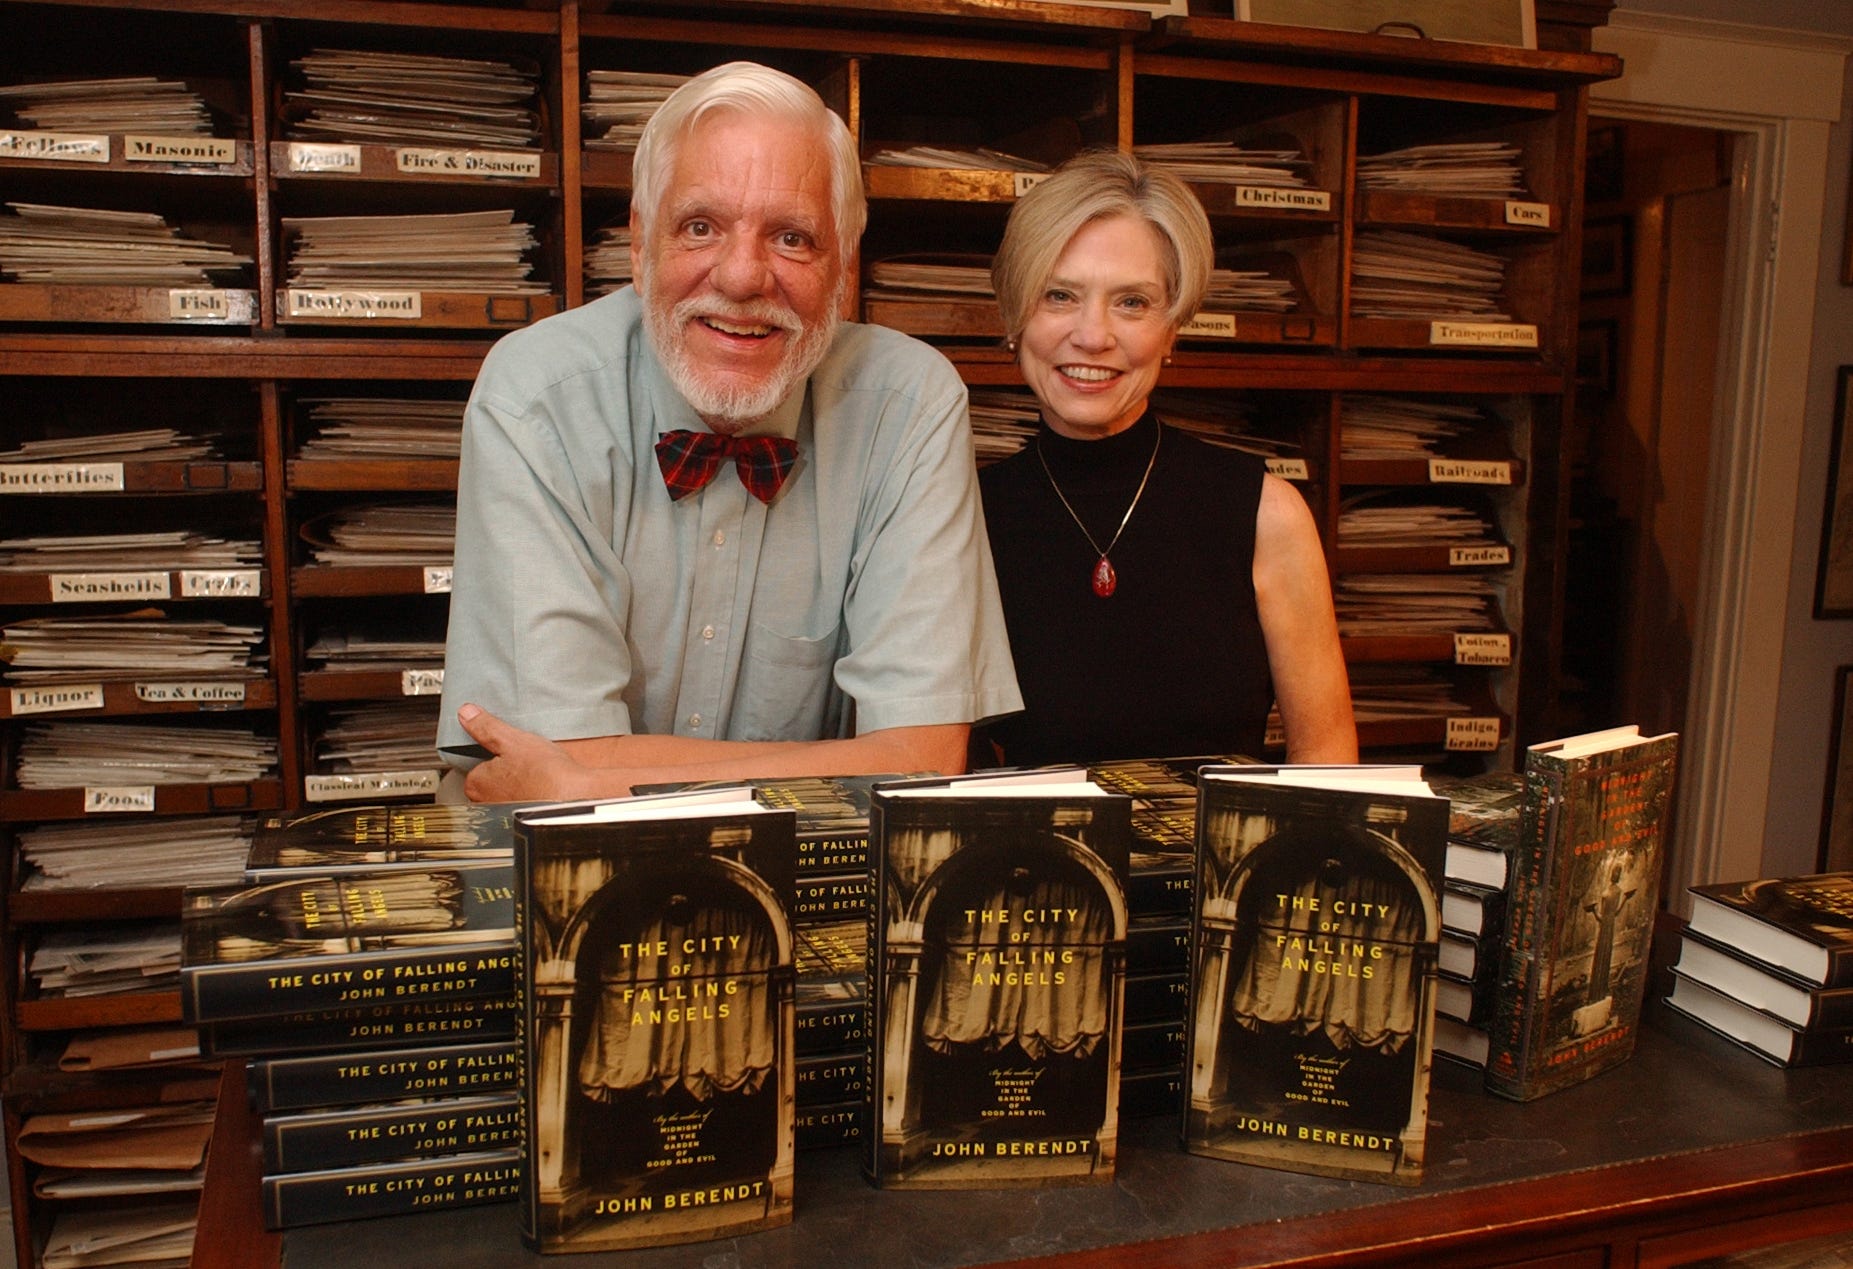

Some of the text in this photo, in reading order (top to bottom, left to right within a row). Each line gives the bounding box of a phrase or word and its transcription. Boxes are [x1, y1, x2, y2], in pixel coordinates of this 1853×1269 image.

[133, 141, 228, 158] Masonic
[403, 153, 535, 174] Fire & Disaster
[1242, 188, 1323, 206] Christmas
[1513, 206, 1542, 219] Cars
[180, 296, 221, 310] Fish
[298, 295, 413, 312] Hollywood
[1435, 466, 1505, 478] Railroads
[1455, 550, 1504, 561] Trades
[60, 579, 163, 594] Seashells
[191, 575, 252, 590] Crabs
[1460, 652, 1509, 663] Tobacco
[19, 689, 94, 707] Liquor
[137, 685, 243, 699] Tea & Coffee
[1449, 738, 1494, 748] Grains
[311, 781, 365, 791] Classical
[94, 791, 148, 806] Food
[799, 839, 868, 852] OF FALLIN
[798, 854, 866, 866] HN BEREN
[809, 887, 826, 897] OF
[832, 884, 867, 895] FALLI
[1166, 880, 1189, 891] THE
[833, 899, 866, 910] BERE
[1276, 894, 1389, 918] THE CITY
[965, 909, 1079, 924] THE CITY
[1321, 922, 1340, 932] OF
[1011, 932, 1031, 942] OF
[620, 935, 741, 958] THE CITY
[1276, 935, 1382, 959] FALLING
[966, 951, 1074, 965] FALLING
[268, 957, 516, 989] THE CITY OF FALLING ANG
[671, 964, 692, 976] OF
[1282, 957, 1374, 979] ANGELS
[972, 971, 1066, 985] ANGELS
[340, 978, 478, 1001] JOHN BERENDT
[623, 980, 738, 1003] FALLING
[632, 1003, 730, 1026] ANGELS
[799, 1013, 856, 1028] HE CITY
[350, 1018, 484, 1037] JOHN BERENDT
[844, 1030, 861, 1039] JO
[338, 1053, 515, 1078] THE CITY OF FALLIN
[1300, 1065, 1339, 1075] MIDNIGHT
[405, 1071, 513, 1089] JOHN BEREN
[799, 1066, 856, 1080] HE CITY
[844, 1082, 860, 1091] JO
[1302, 1080, 1335, 1090] GARDEN
[1285, 1092, 1308, 1101] GOOD
[1331, 1099, 1349, 1107] EVIL
[348, 1112, 519, 1141] THE CITY OF FALLI
[796, 1112, 855, 1127] HE CITY
[660, 1123, 703, 1133] MIDNIGHT
[843, 1128, 859, 1137] JO
[1237, 1118, 1394, 1150] JOHN BERENDT
[415, 1137, 457, 1150] JOHN
[680, 1133, 696, 1141] THE
[664, 1141, 699, 1150] GARDEN
[933, 1140, 1090, 1156] JOHN BERENDT
[646, 1155, 716, 1168] GOOD AND EVIL
[346, 1168, 520, 1196] THE CITY OF FALLIN
[412, 1185, 519, 1205] JOHN BEREN
[595, 1182, 764, 1215] JOHN BERENDT
